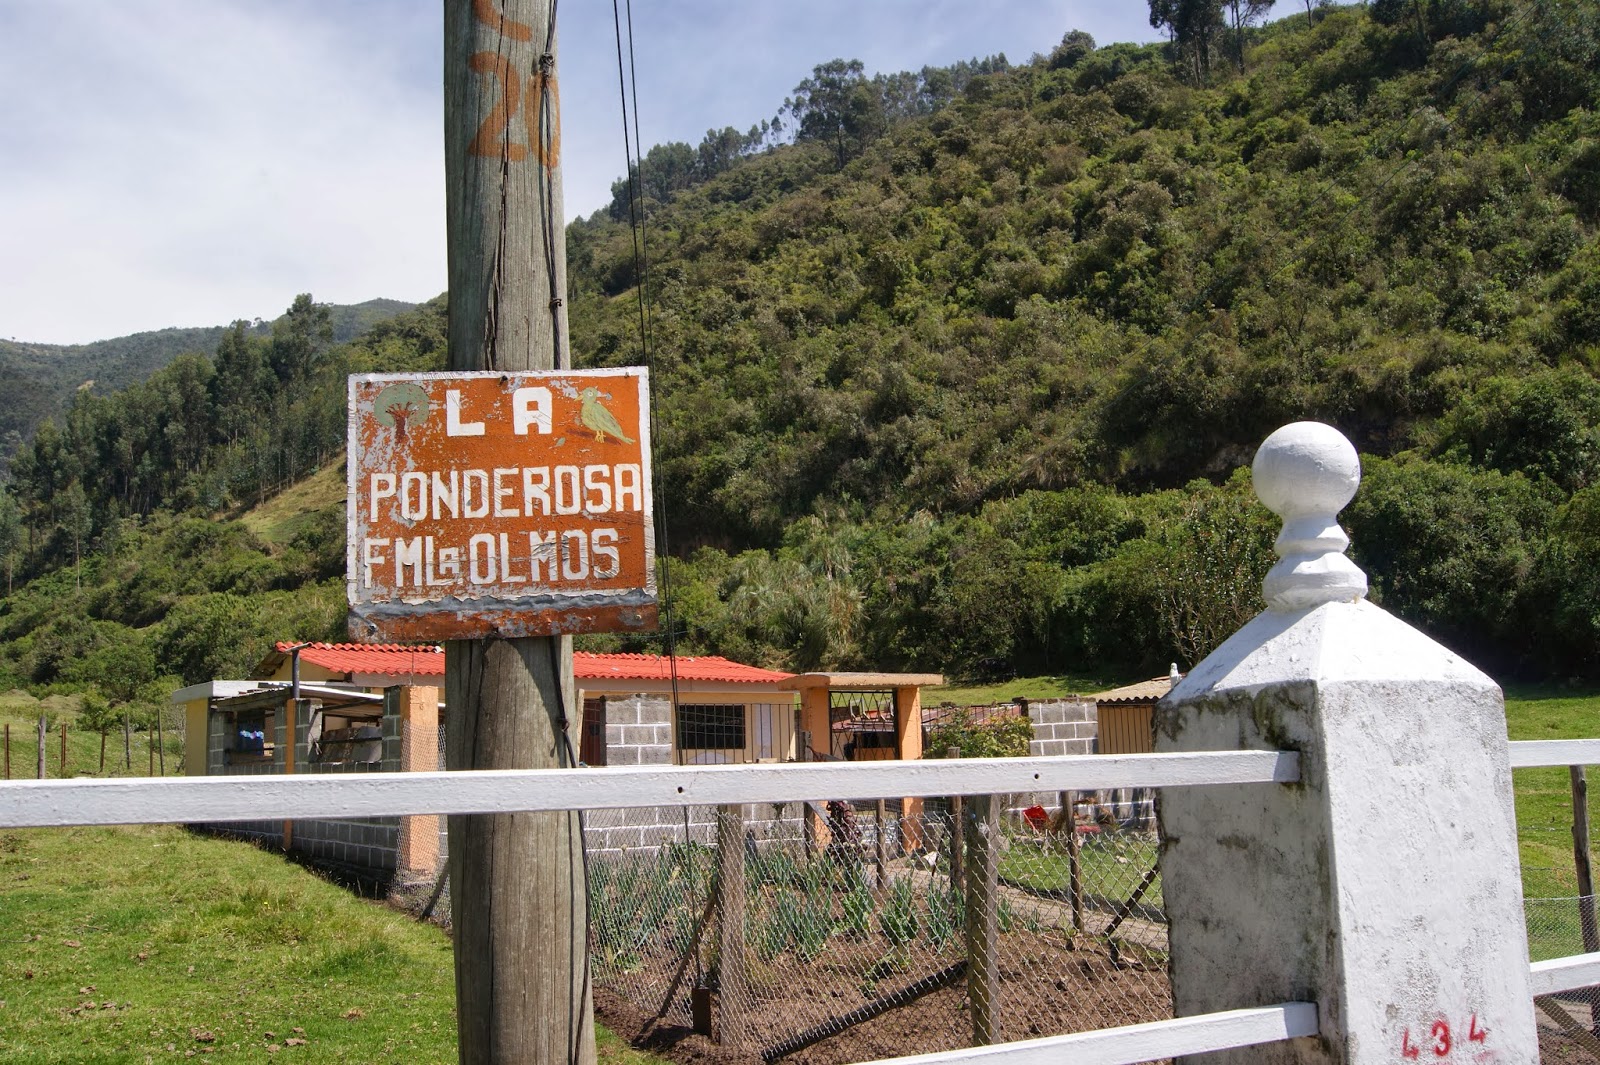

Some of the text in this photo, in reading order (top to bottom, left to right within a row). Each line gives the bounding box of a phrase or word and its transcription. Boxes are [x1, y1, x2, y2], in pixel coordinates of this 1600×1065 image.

[446, 387, 552, 436] LA
[370, 463, 642, 523] PONDEROSA
[469, 528, 619, 586] OLMOS
